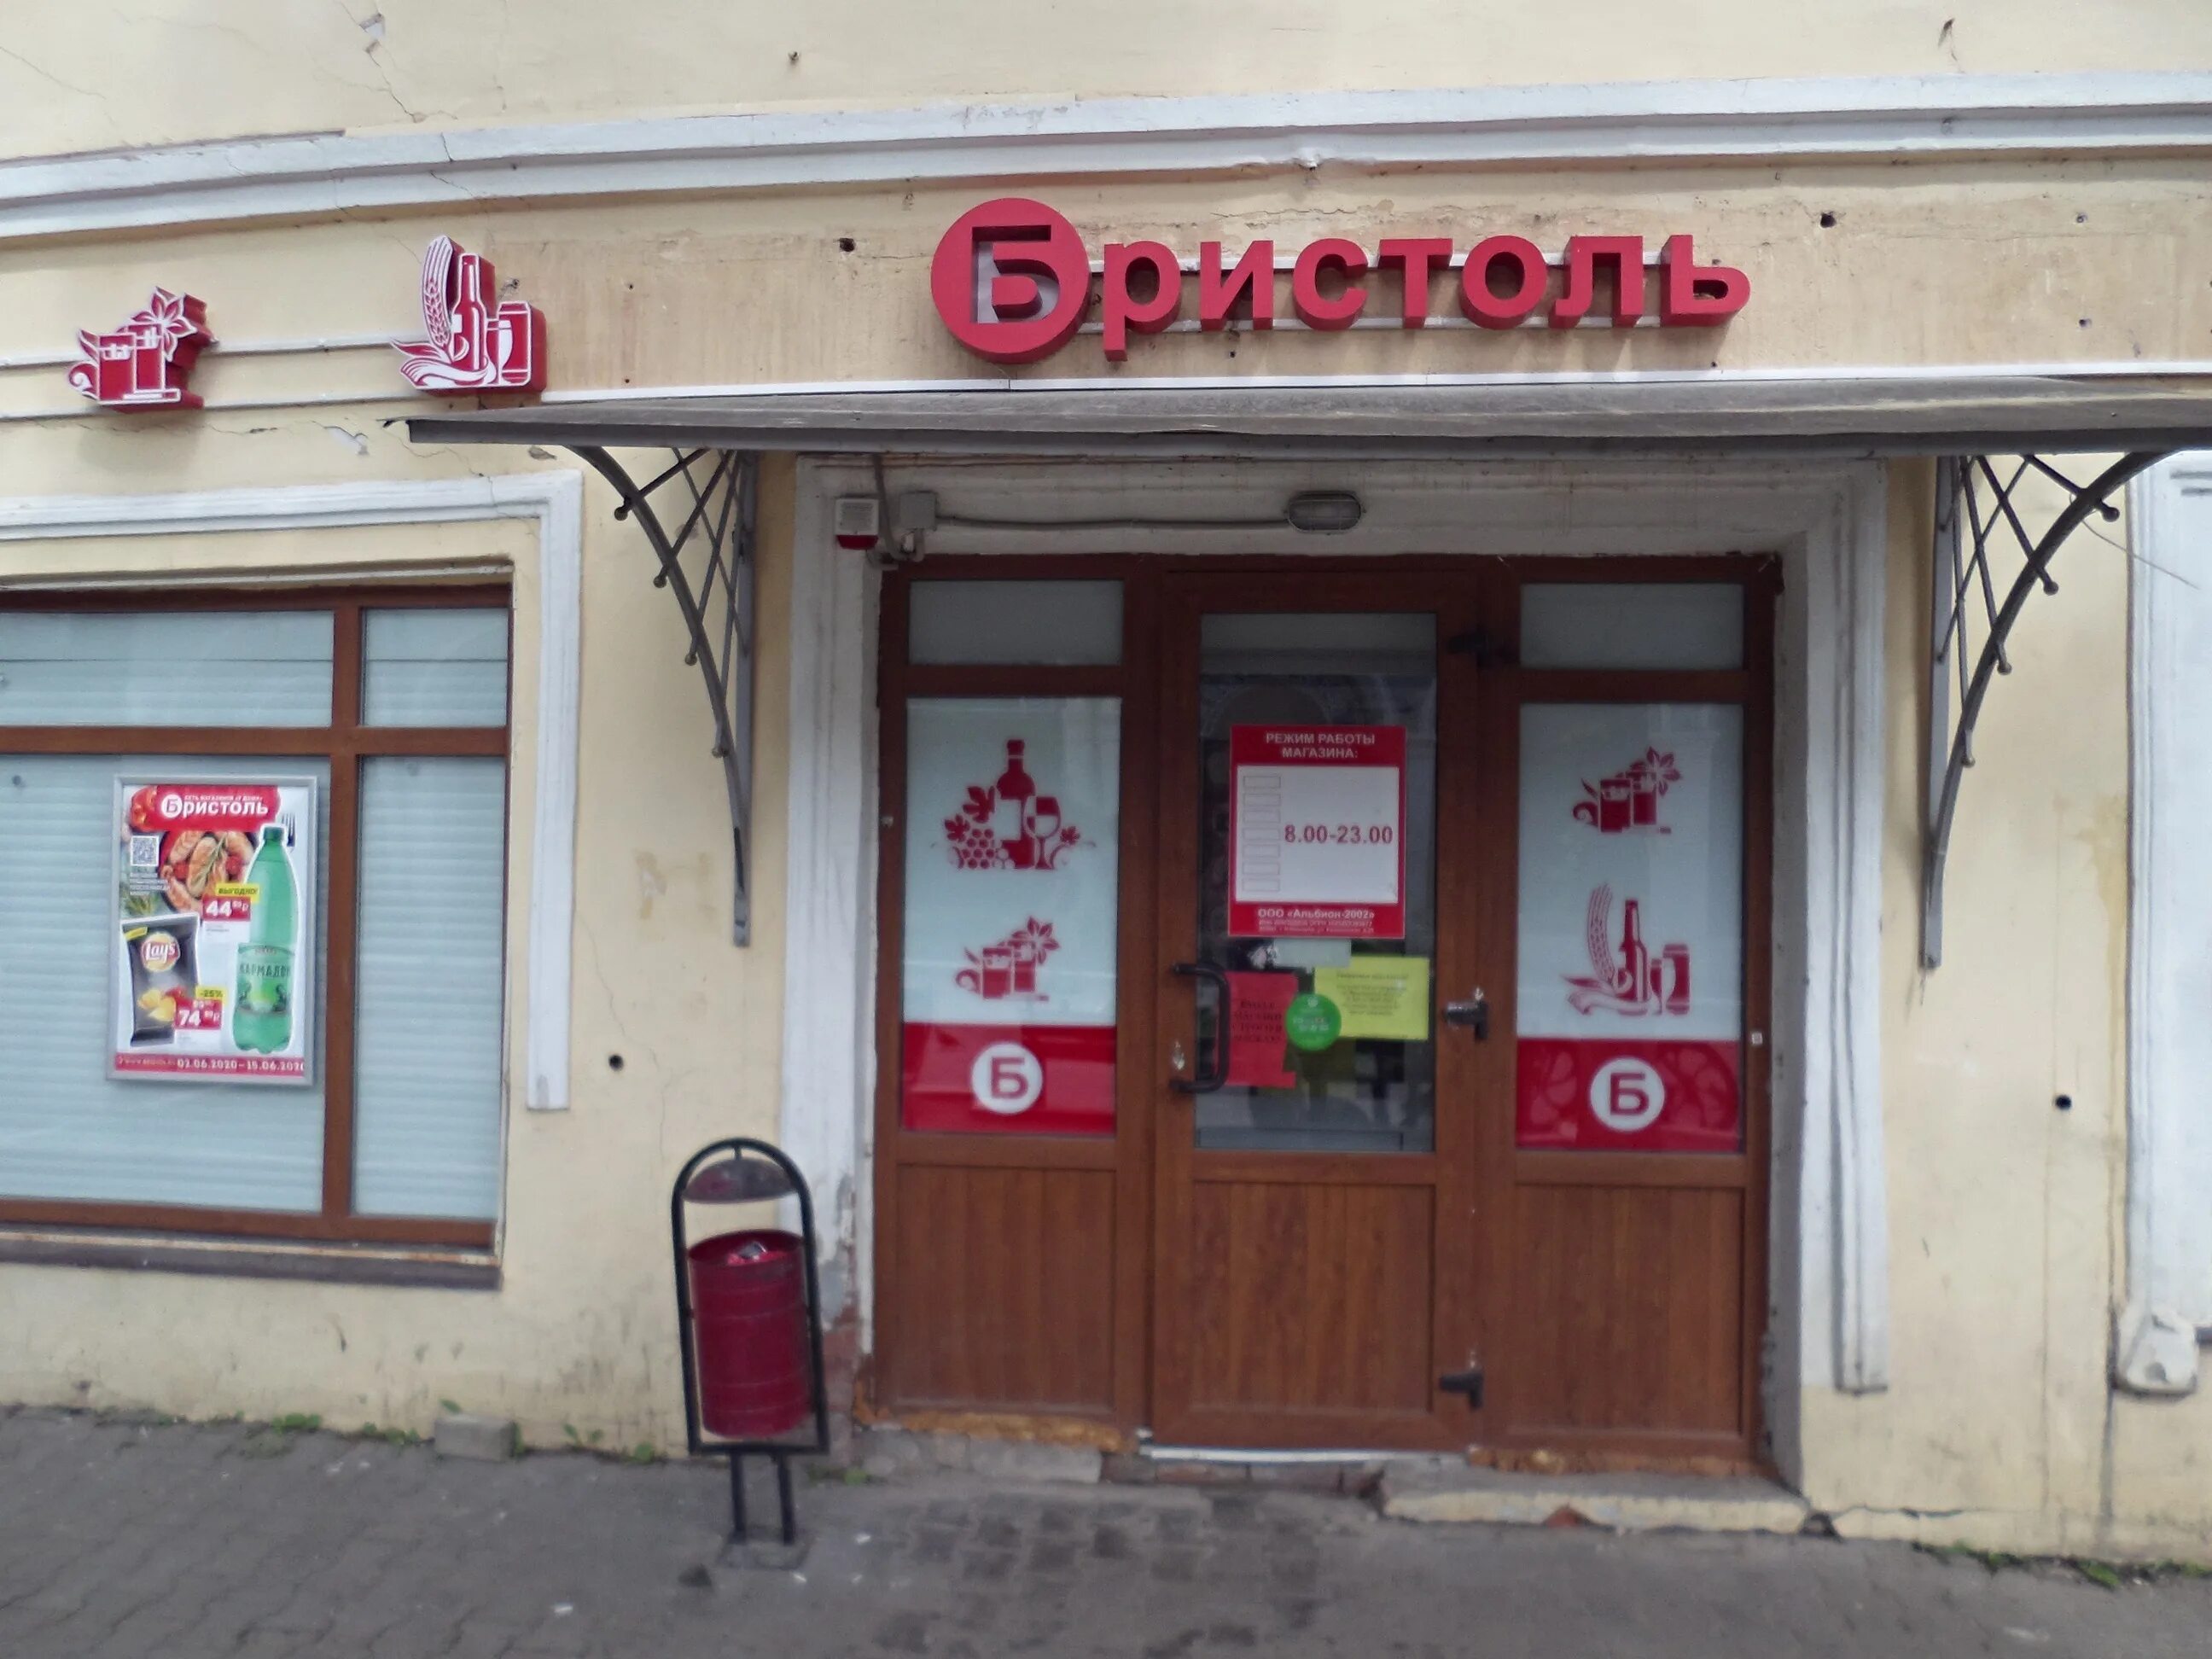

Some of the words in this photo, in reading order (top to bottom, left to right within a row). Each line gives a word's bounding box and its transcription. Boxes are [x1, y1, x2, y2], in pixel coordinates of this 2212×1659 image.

[930, 198, 1749, 363] Бристоль
[1266, 731, 1314, 744] РЕЖИМ
[1318, 732, 1376, 745] РАБОТЫ
[1282, 747, 1359, 759] МАГАЗИНА:
[161, 795, 269, 818] Бристоль
[1284, 824, 1393, 844] 8.00-23.00
[1258, 908, 1284, 918] ООО
[990, 1057, 1028, 1099] Б
[1610, 1072, 1650, 1115] Б
